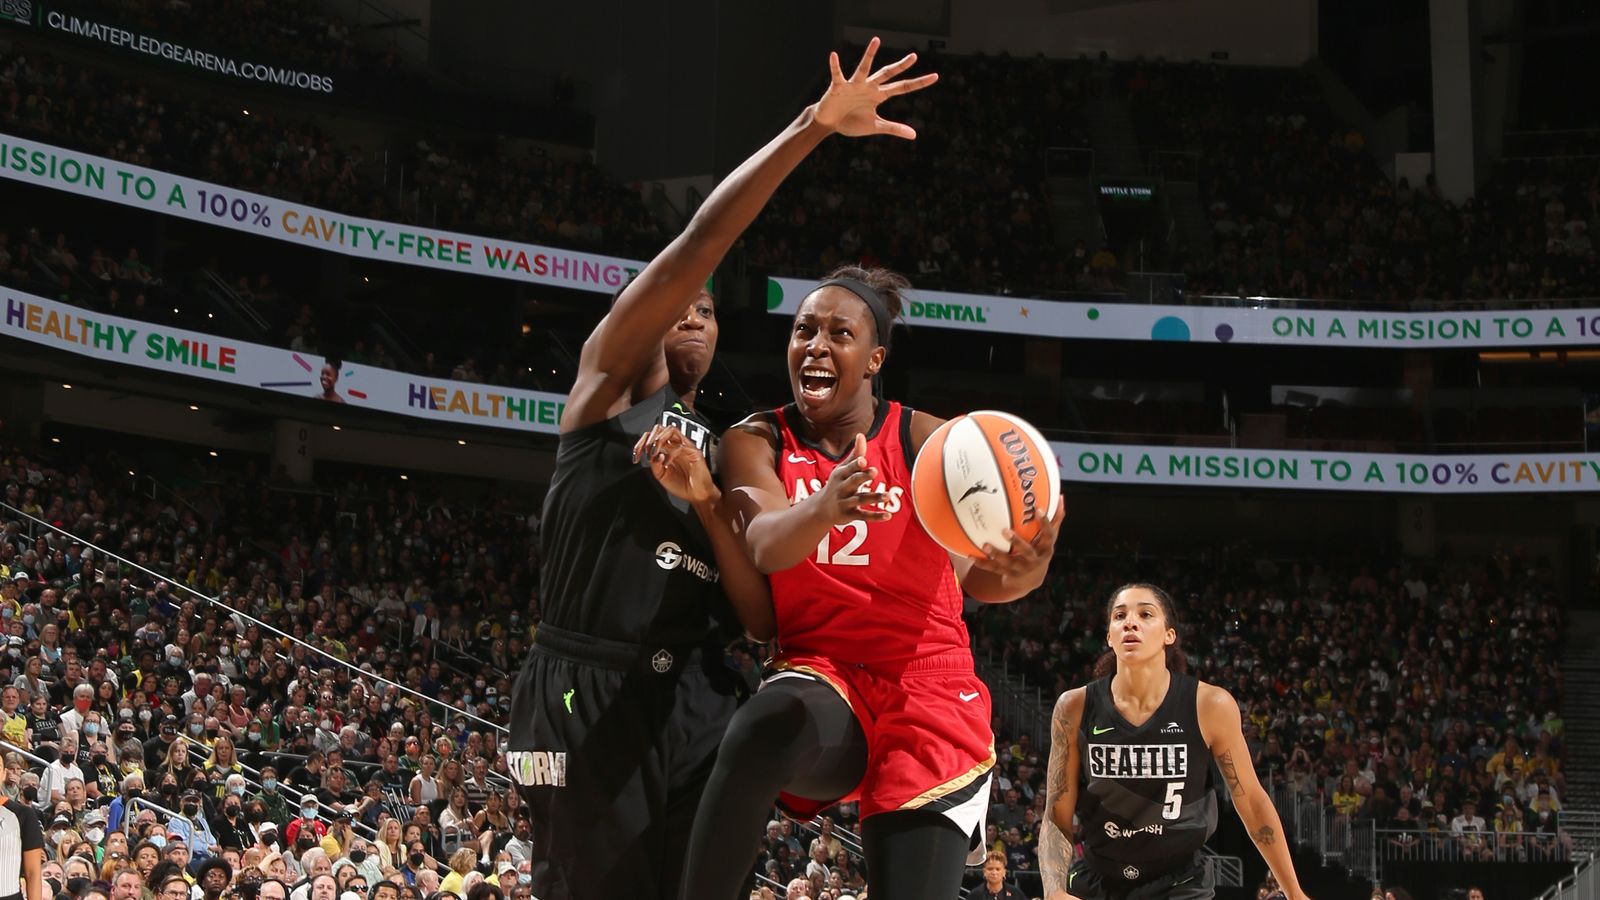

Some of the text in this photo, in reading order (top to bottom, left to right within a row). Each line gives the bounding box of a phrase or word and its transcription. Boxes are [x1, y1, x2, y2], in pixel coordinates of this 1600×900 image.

[48, 11, 333, 93] CLIMATEPLEDGEARENA.COM/JOBS
[1, 143, 105, 192] ISSION
[117, 170, 156, 200] TO
[167, 184, 187, 208] A
[198, 190, 271, 228] 100%
[282, 210, 472, 264] CAVITY-FREE
[6, 298, 236, 373] HEALTHY SMILE
[1272, 316, 1315, 337] ON
[1327, 318, 1346, 338] A
[1358, 318, 1481, 340] MISSION
[1493, 317, 1533, 338] TO
[1546, 317, 1566, 337] A
[999, 428, 1037, 528] Wilson
[1078, 452, 1122, 475] ON
[1136, 454, 1156, 476] A
[1169, 455, 1298, 480] MISSION
[1311, 459, 1352, 482] TO
[1364, 462, 1384, 483] A
[1396, 462, 1479, 485] 100%
[816, 519, 869, 565] 12
[1091, 746, 1185, 776] SEATTLE
[1162, 781, 1185, 820] 5
